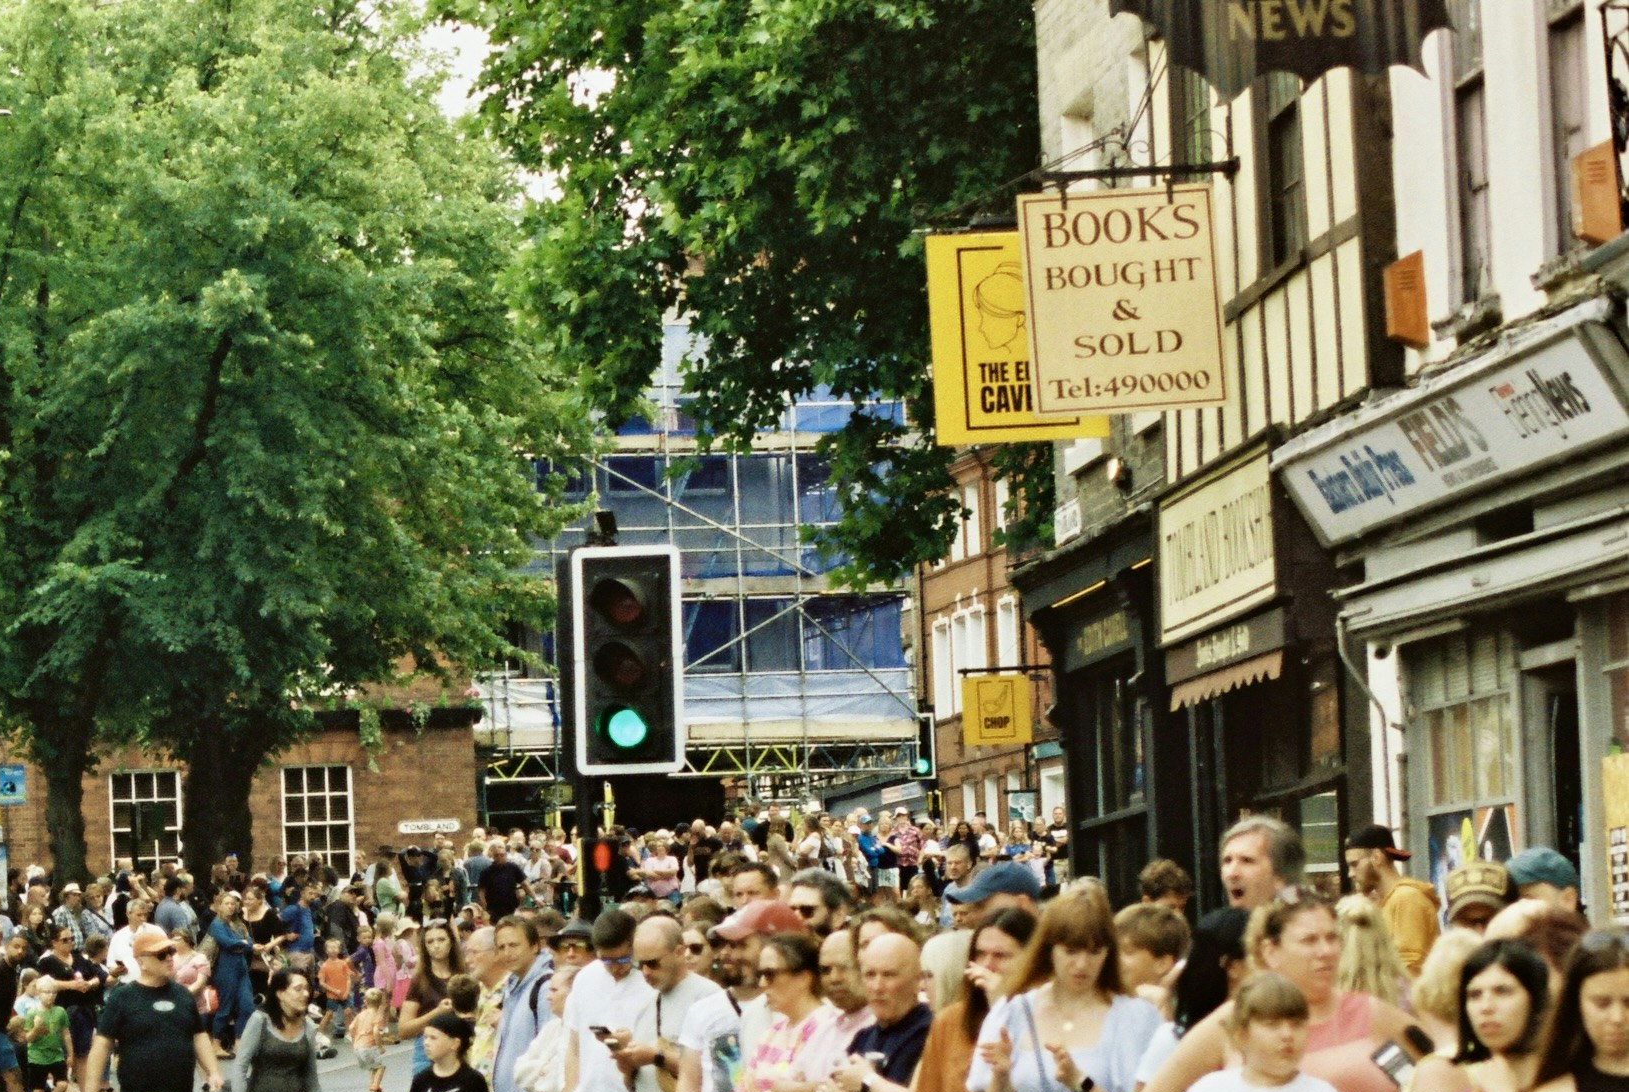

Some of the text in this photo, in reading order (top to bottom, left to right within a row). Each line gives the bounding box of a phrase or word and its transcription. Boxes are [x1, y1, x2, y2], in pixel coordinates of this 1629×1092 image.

[1227, 0, 1356, 41] NEWS
[1042, 203, 1200, 249] BOOKS
[1044, 256, 1202, 292] BOUGHT
[1112, 299, 1141, 321] &
[1074, 329, 1183, 359] SOLD
[978, 362, 1009, 383] THE
[1049, 370, 1210, 400] Tel:490000
[984, 716, 1010, 729] CHOP
[404, 822, 455, 832] TOMBLAND
